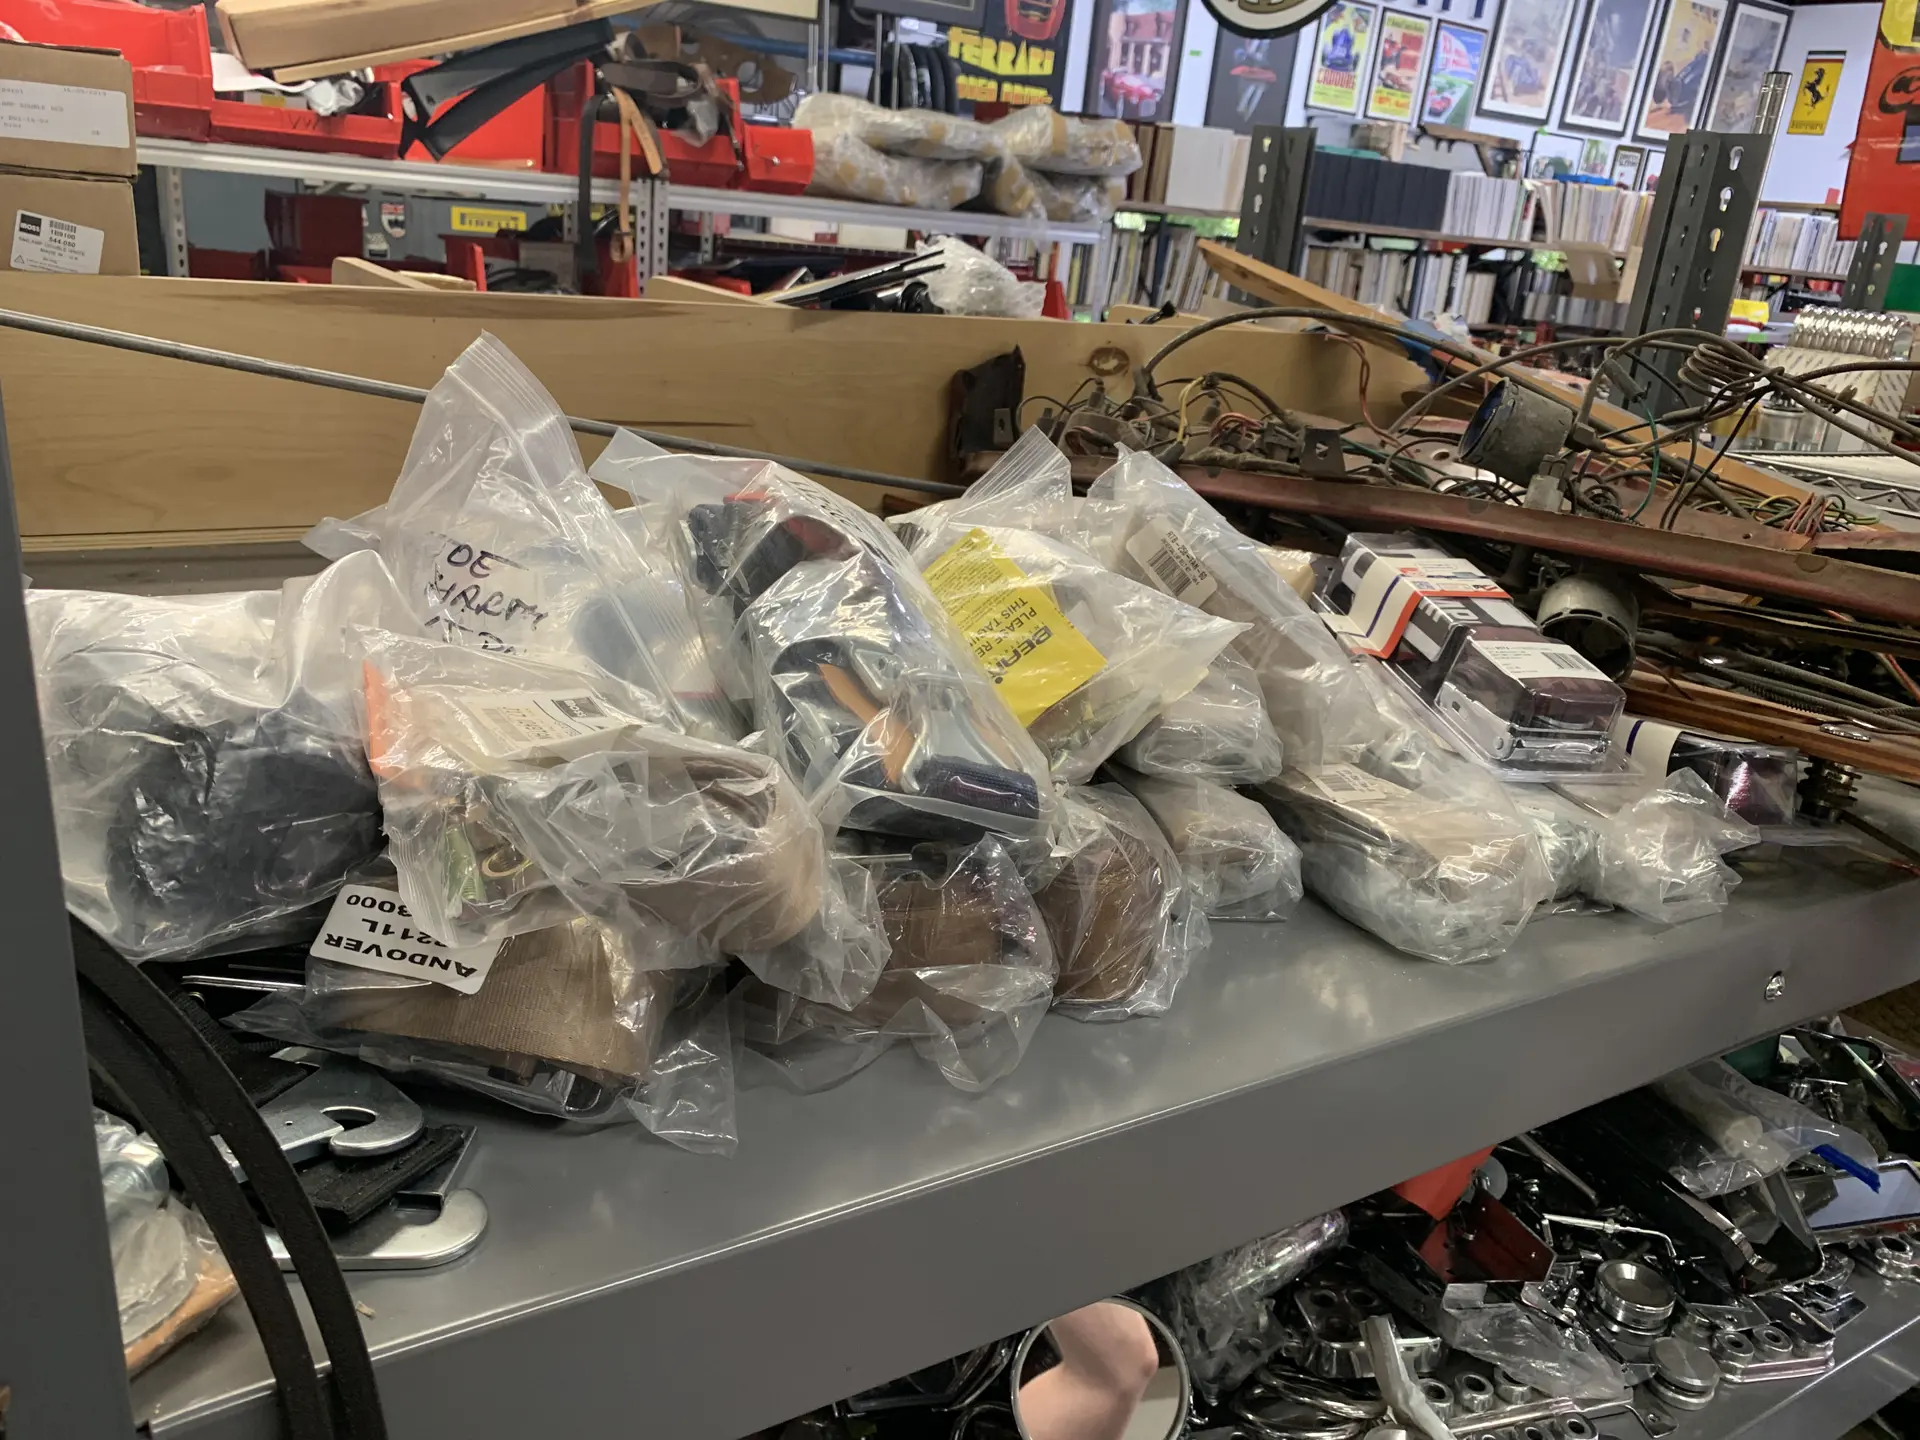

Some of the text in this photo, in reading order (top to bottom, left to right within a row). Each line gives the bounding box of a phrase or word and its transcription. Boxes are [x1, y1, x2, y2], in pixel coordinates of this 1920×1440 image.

[947, 26, 1055, 75] FERRARI
[994, 606, 1037, 645] PLEASE
[1000, 596, 1029, 619] THIS
[323, 932, 478, 978] ANDOVER
